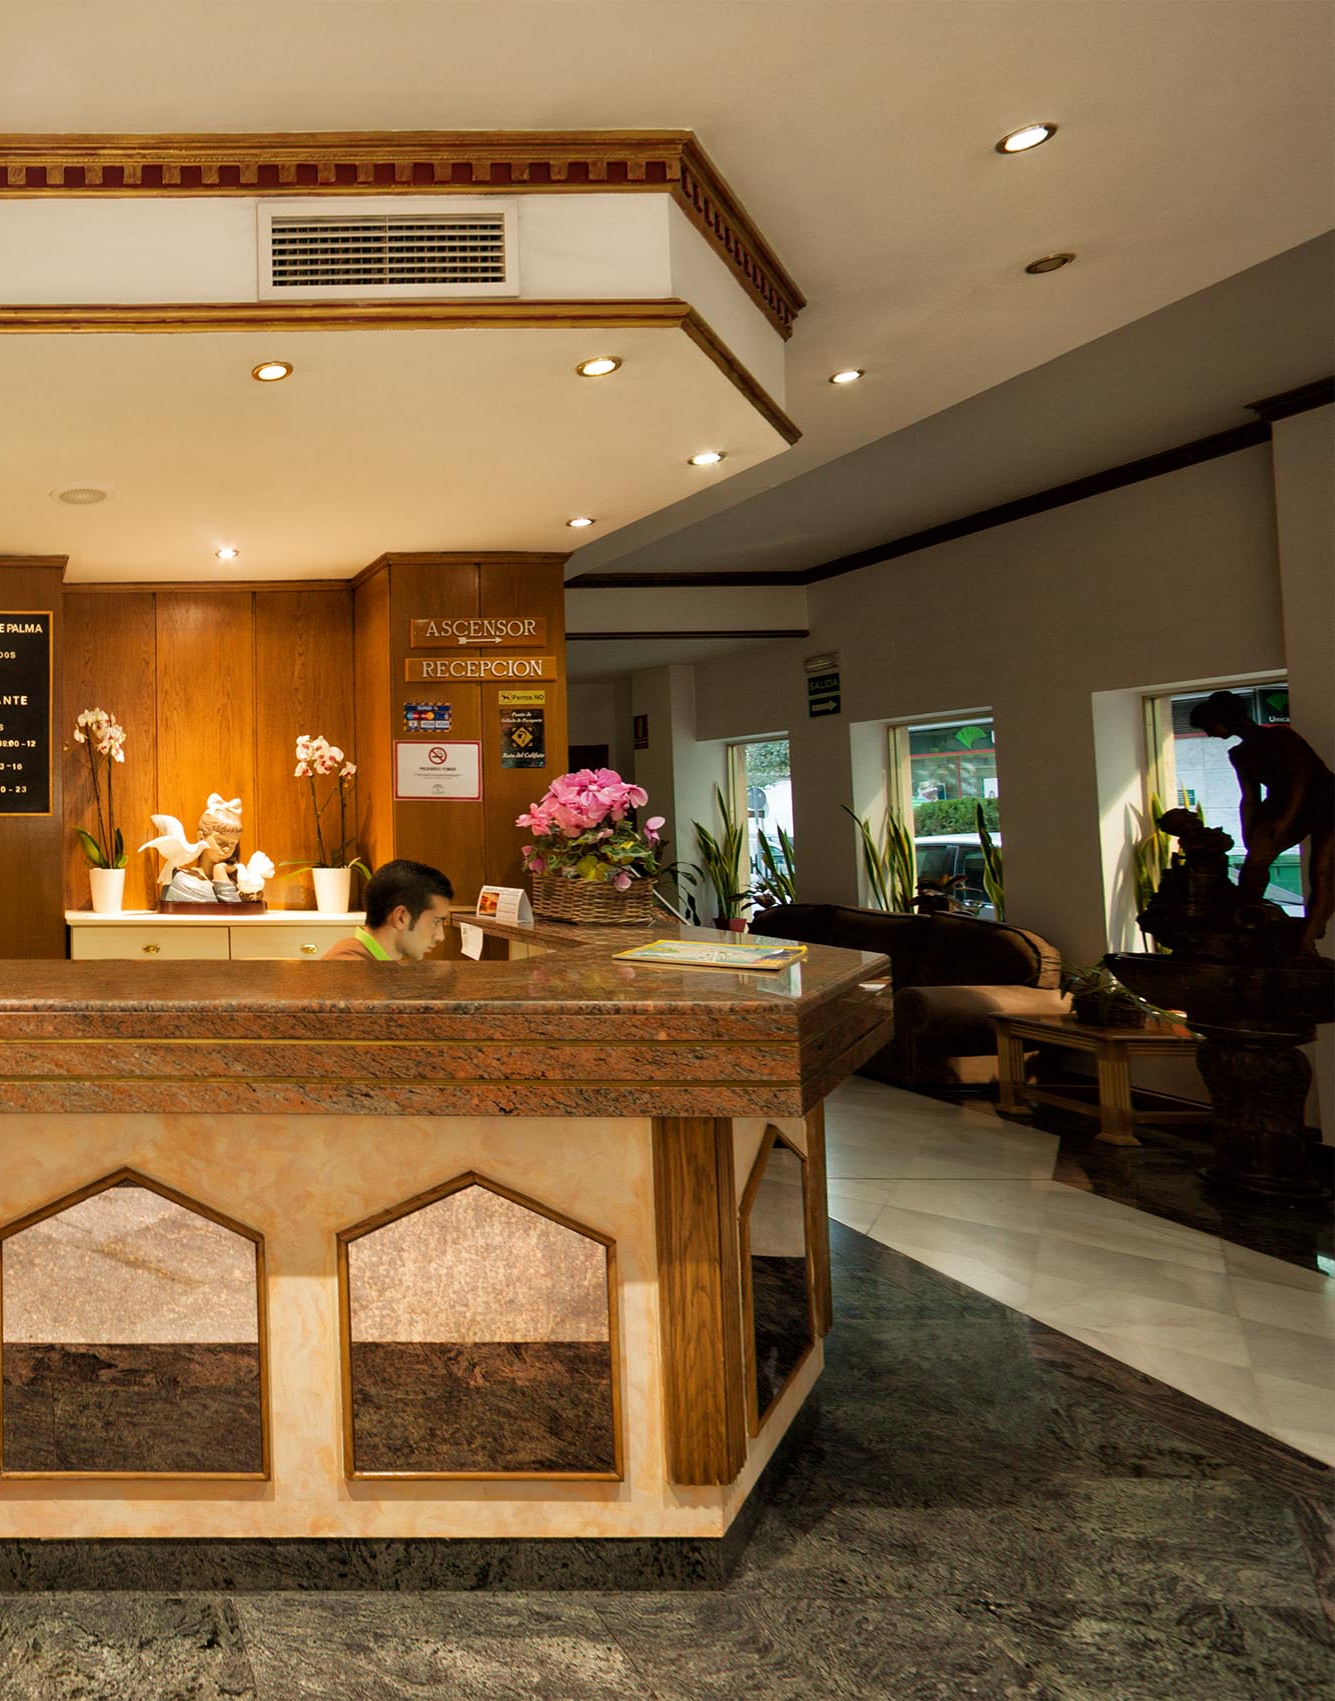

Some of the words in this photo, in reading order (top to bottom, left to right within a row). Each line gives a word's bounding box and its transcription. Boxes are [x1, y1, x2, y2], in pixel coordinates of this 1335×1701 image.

[426, 619, 537, 637] ASCENSOR
[422, 660, 543, 678] RECEPCION
[809, 678, 838, 691] SALIDA
